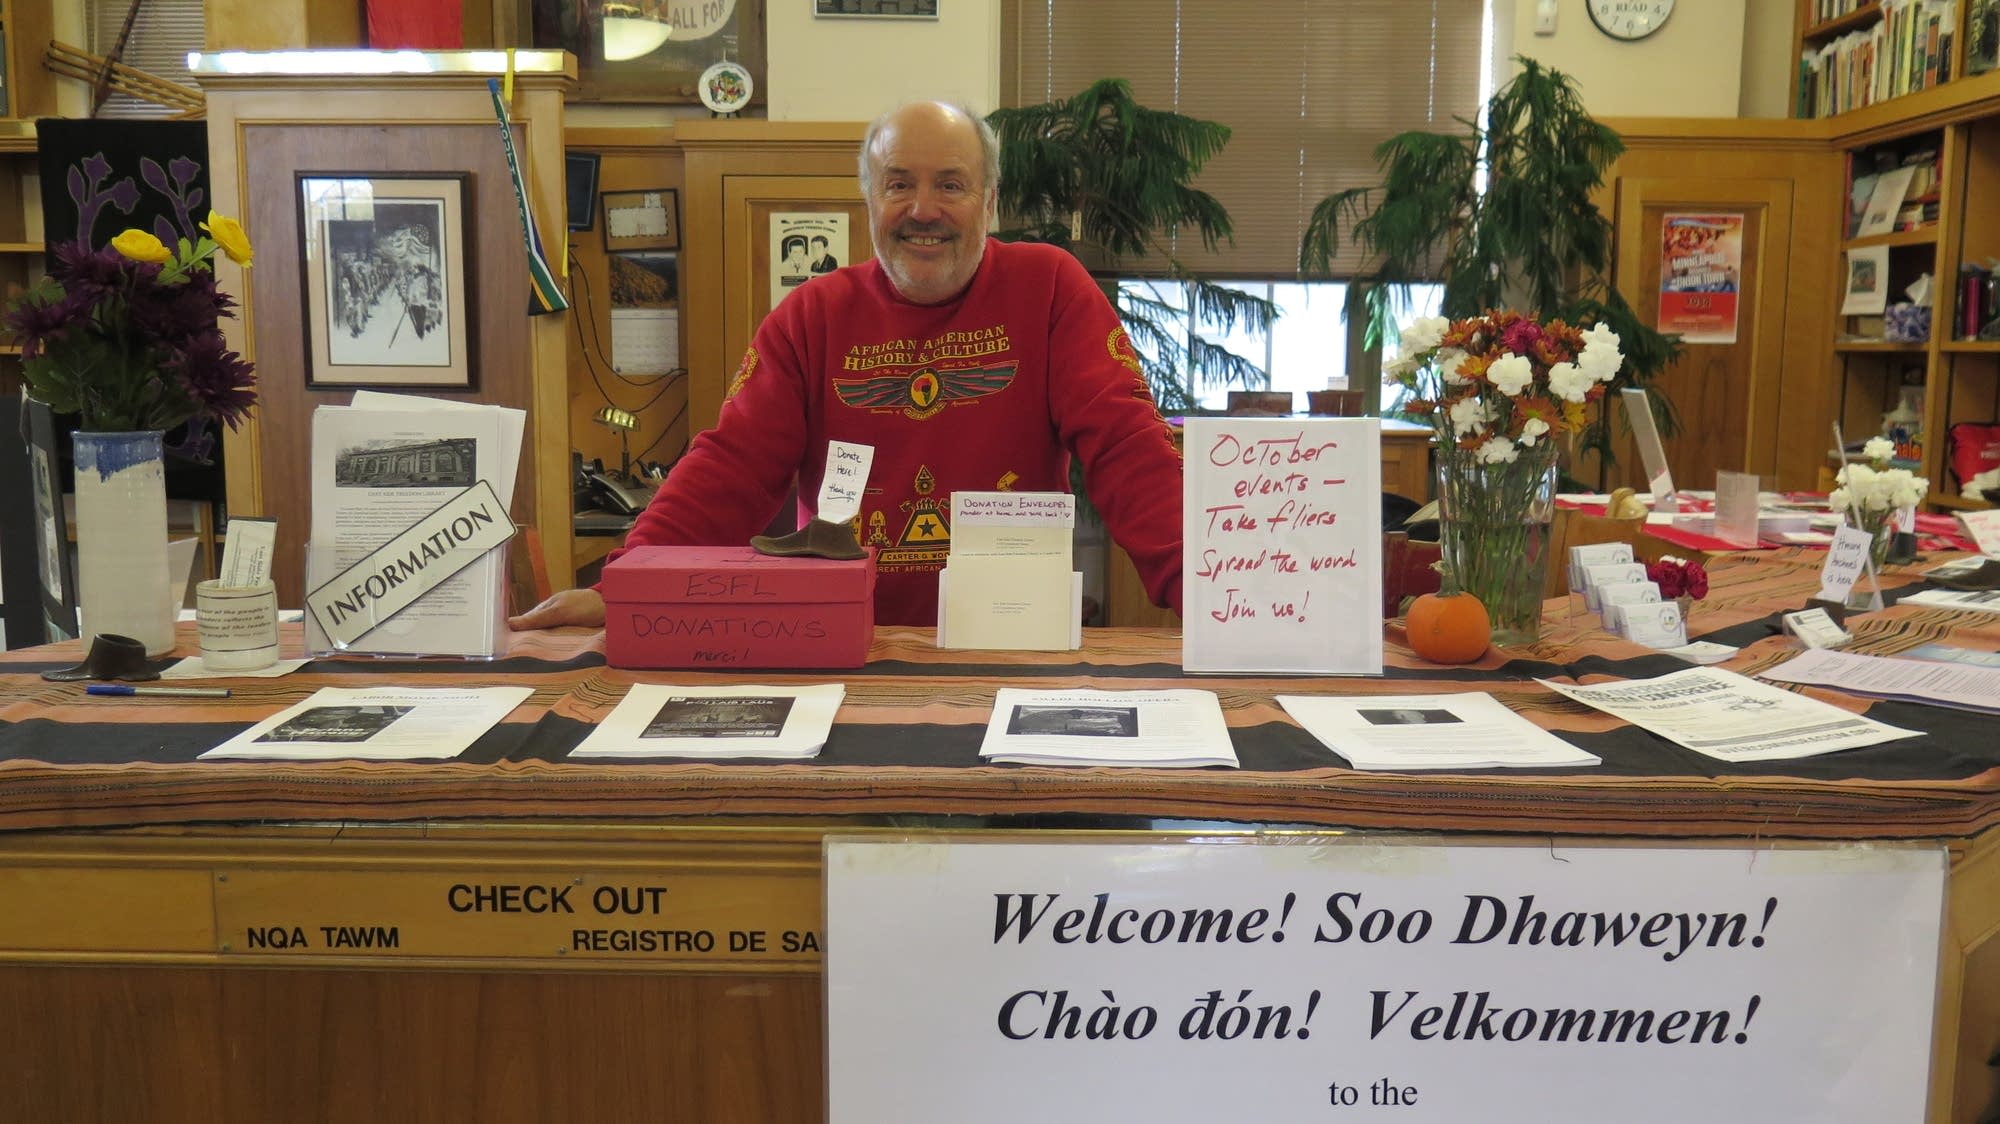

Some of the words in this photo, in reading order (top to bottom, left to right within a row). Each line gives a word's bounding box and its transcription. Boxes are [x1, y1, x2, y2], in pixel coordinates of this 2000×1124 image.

[672, 7, 698, 29] ALL
[703, 0, 726, 28] FOR
[1616, 3, 1648, 12] READ
[843, 352, 914, 371] HISTORY
[918, 352, 929, 363] &
[932, 336, 1010, 360] CULTURE
[850, 339, 917, 356] AFRICAN
[923, 324, 1006, 351] AMERICAN
[837, 446, 862, 463] Donate
[1210, 431, 1337, 467] October
[1234, 473, 1309, 498] events
[964, 498, 1013, 508] DONATION
[1206, 505, 1257, 538] Take
[1267, 499, 1336, 533] fliers
[326, 503, 494, 626] INFORMATION
[887, 552, 918, 560] CARTER
[1196, 549, 1267, 582] Spread
[1270, 549, 1299, 575] the
[1310, 549, 1357, 571] word
[686, 572, 777, 598] ESFL
[1211, 588, 1256, 623] Join
[1272, 590, 1310, 623] us!
[631, 613, 826, 640] DONATIONS
[447, 884, 575, 914] CHECK
[592, 886, 667, 915] OUT
[247, 927, 309, 950] NQA
[320, 926, 399, 949] TAWM
[572, 929, 715, 952] REGISTRO
[729, 930, 766, 952] DE
[992, 892, 1297, 944] Welcome!
[1314, 892, 1433, 944] Soo
[1449, 894, 1778, 963] Dhaweyn!
[997, 989, 1158, 1041] Chào
[1178, 989, 1321, 1041] đón!
[1369, 990, 1761, 1045] Velkommen!
[1328, 1080, 1359, 1106] to
[1370, 1077, 1418, 1106] the
